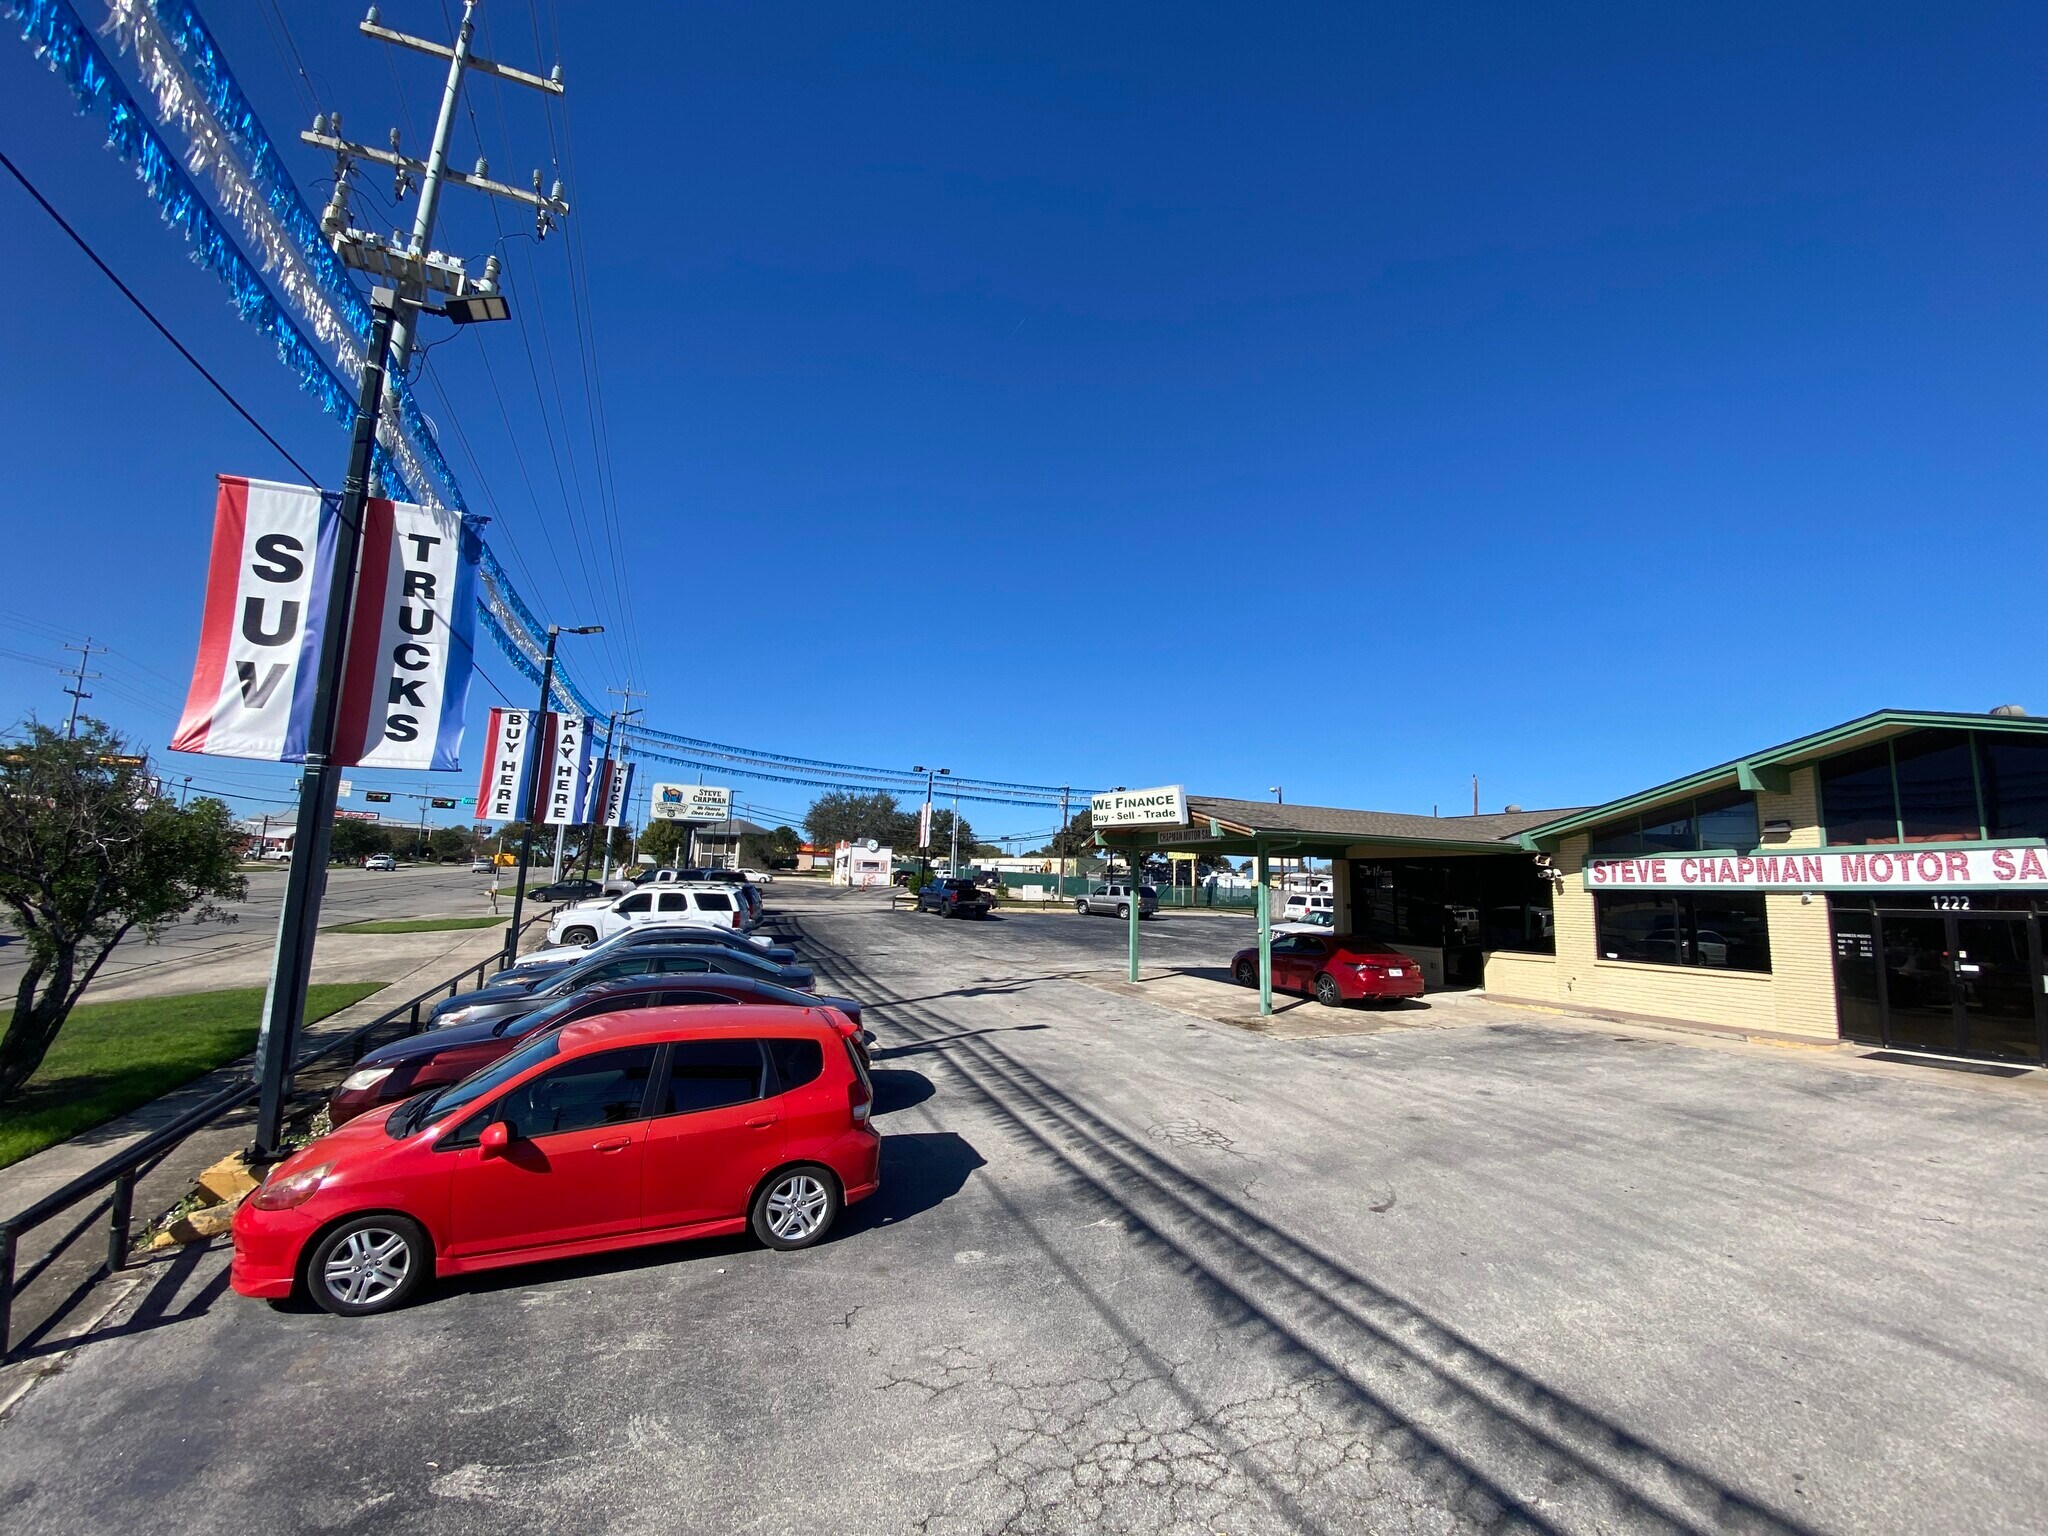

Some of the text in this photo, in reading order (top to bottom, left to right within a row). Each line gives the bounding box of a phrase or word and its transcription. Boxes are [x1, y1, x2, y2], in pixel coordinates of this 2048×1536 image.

[235, 533, 304, 709] SUV
[385, 533, 441, 742] TRUCKS
[496, 714, 522, 814] BUY HERE
[553, 720, 577, 819] PAY HERE
[607, 767, 624, 820] TRUCKS
[692, 795, 727, 804] CHAPMAN
[699, 789, 722, 797] STEVE
[1092, 813, 1109, 823] Buy
[1116, 811, 1135, 820] Sell
[1143, 809, 1176, 819] Trade
[1183, 830, 1201, 841] MOTOR
[1593, 848, 2048, 883] STEVE CHAPMAN MOTOR SA
[1931, 895, 1971, 910] 1222
